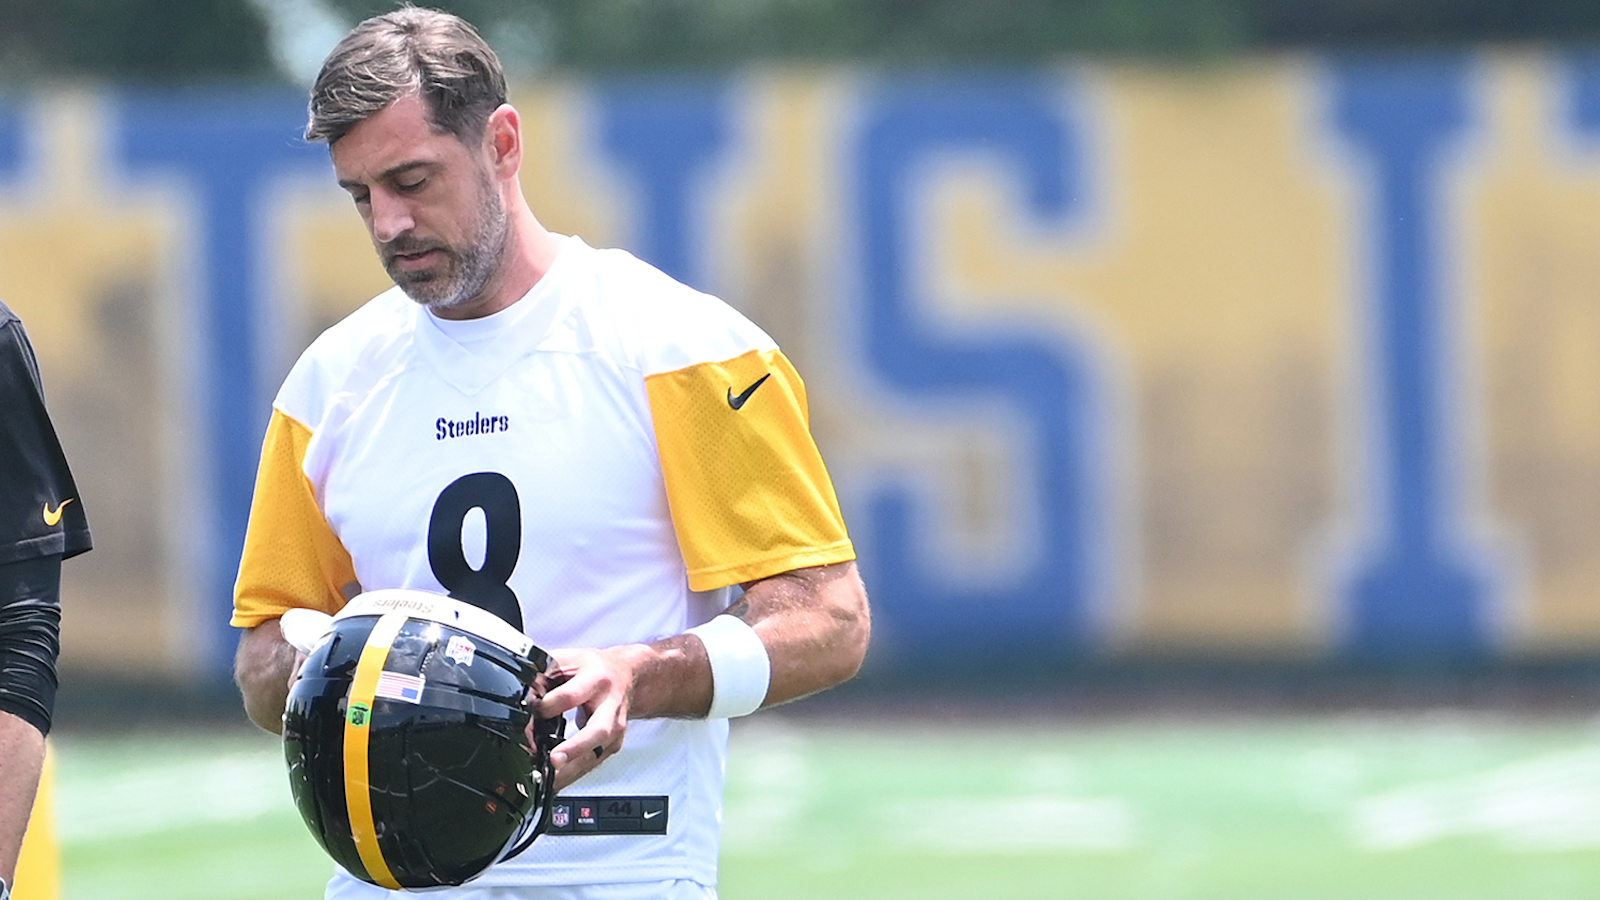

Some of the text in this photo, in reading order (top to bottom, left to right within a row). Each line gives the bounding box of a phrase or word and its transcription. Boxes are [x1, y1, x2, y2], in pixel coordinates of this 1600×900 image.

[435, 411, 509, 440] Steelers
[428, 471, 523, 634] 8
[373, 599, 434, 614] Steelers
[607, 801, 632, 815] 44
